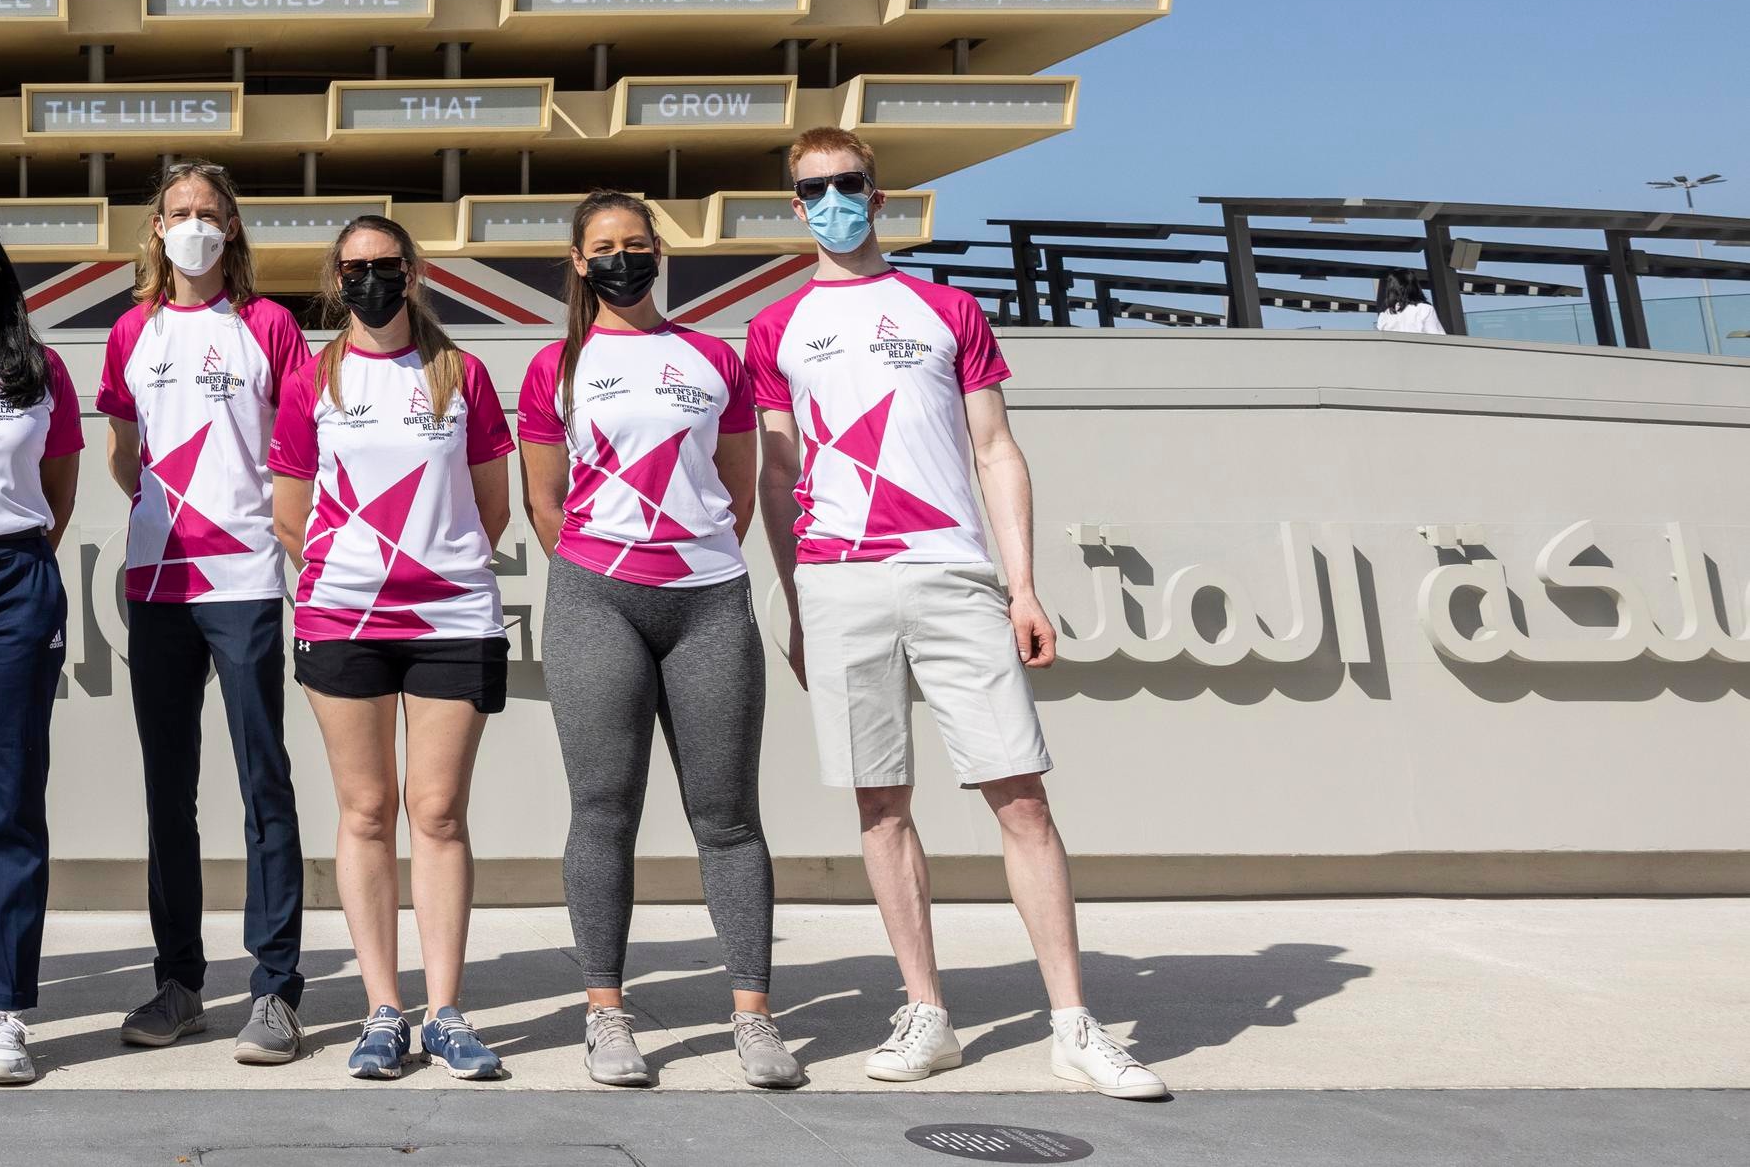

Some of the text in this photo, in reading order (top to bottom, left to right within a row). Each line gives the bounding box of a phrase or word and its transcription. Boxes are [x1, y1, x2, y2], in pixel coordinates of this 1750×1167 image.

[46, 100, 217, 123] THE LILIES
[400, 96, 482, 119] THAT
[659, 93, 750, 117] GROW
[870, 342, 932, 353] QUEEN'S BATON
[889, 350, 914, 358] RELAY
[655, 387, 713, 402] QUEEN'S BATON
[677, 394, 701, 405] RELAY
